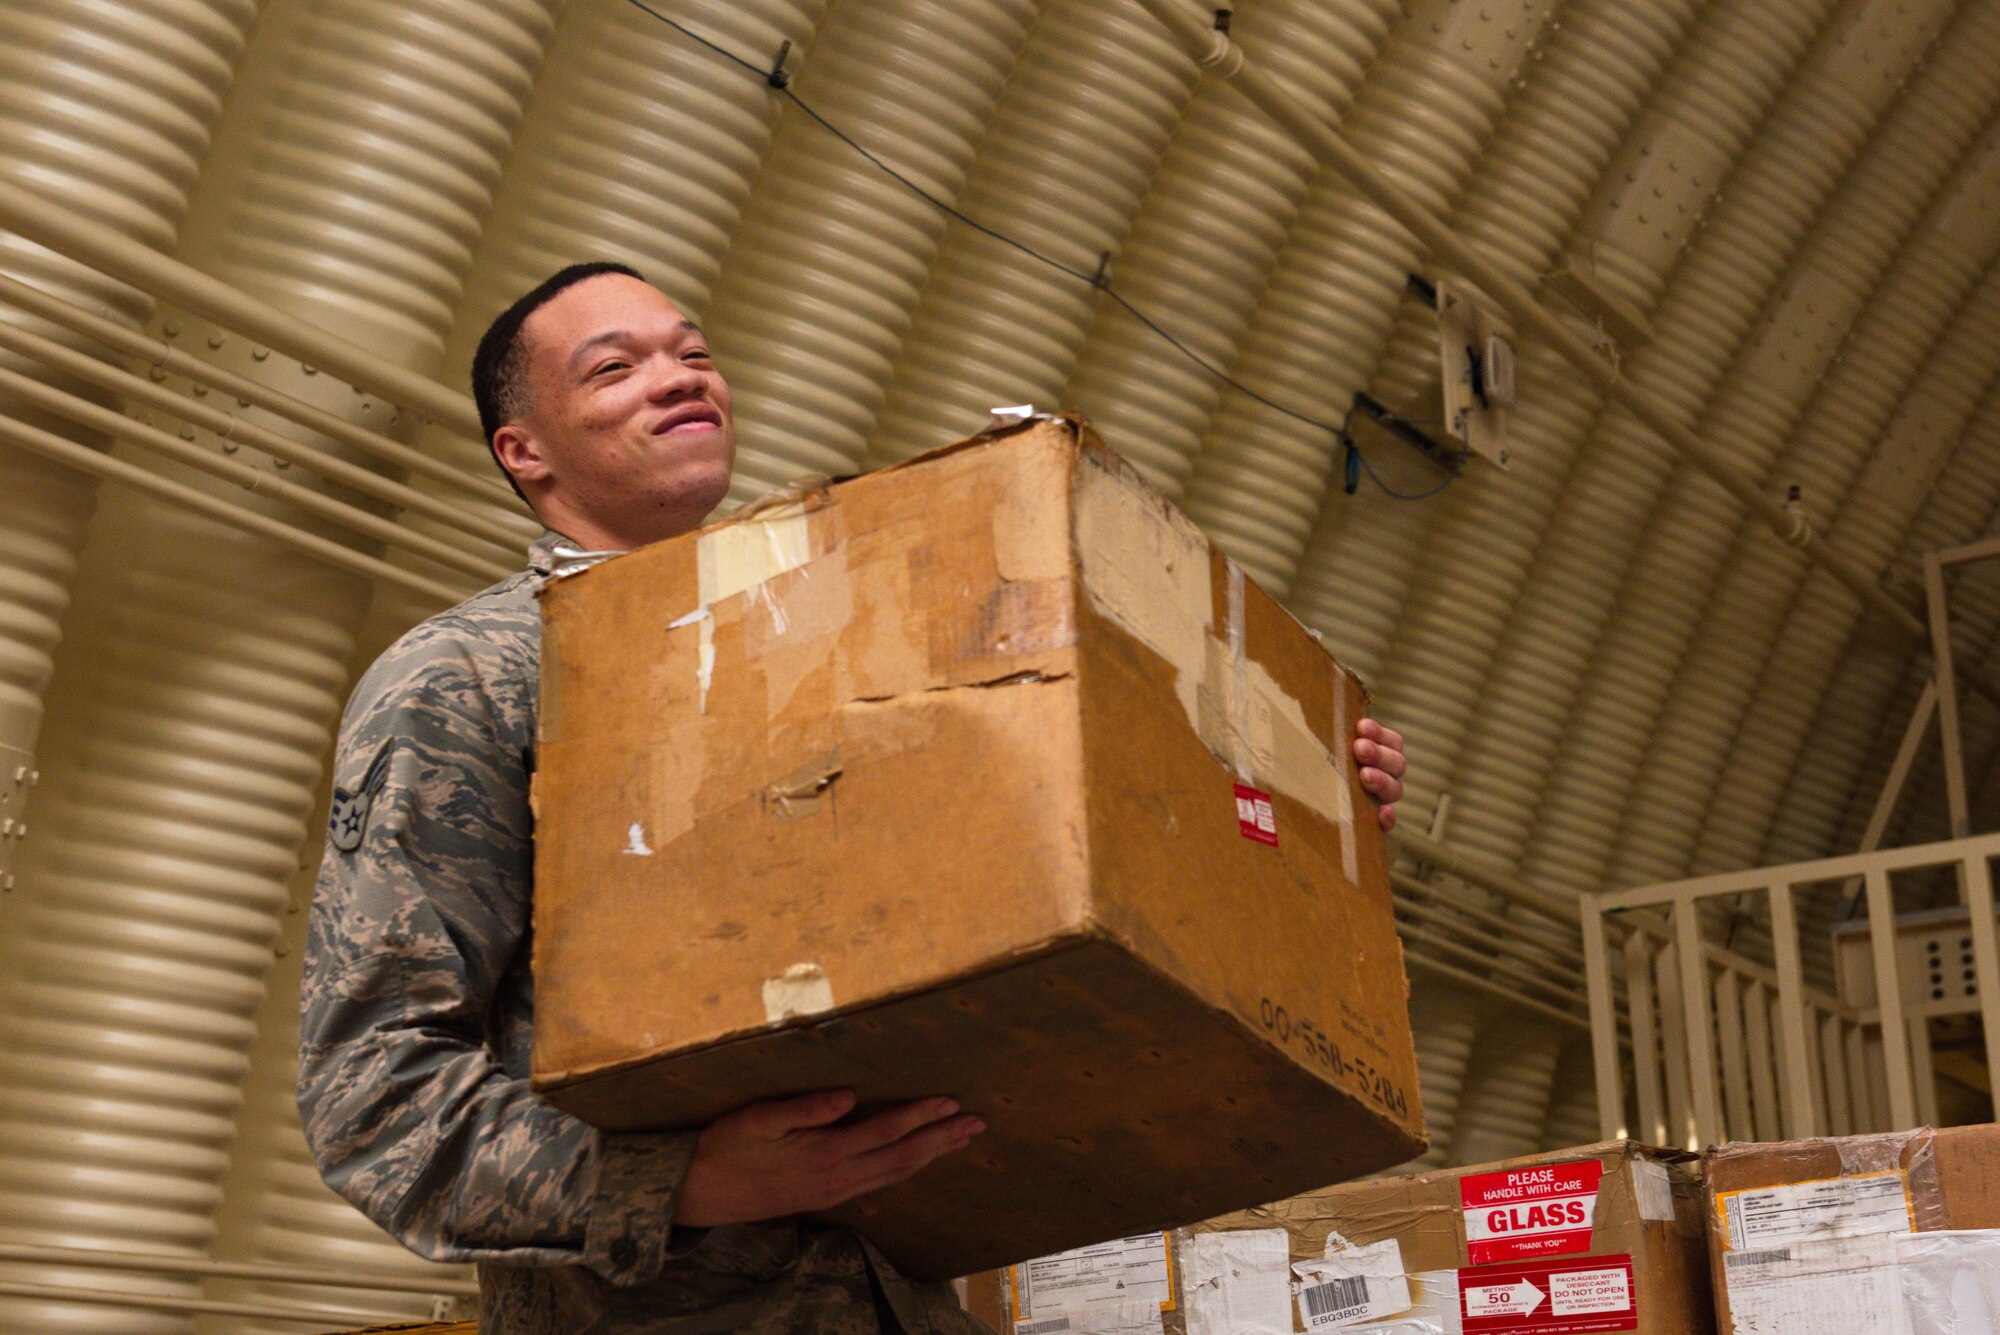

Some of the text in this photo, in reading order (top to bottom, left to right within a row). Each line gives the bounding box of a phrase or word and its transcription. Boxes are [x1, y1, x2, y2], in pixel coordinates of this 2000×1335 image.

[1508, 1170, 1554, 1186] PLEASE
[1484, 1180, 1582, 1200] HANDLE WITH CARE
[1487, 1200, 1586, 1233] GLASS
[1556, 1274, 1598, 1282] PACKAGED
[1566, 1280, 1611, 1288] DESICCANT
[1596, 1286, 1624, 1294] OPEN
[1488, 1292, 1510, 1304] 50
[1312, 1306, 1368, 1326] EBQ3BDC
